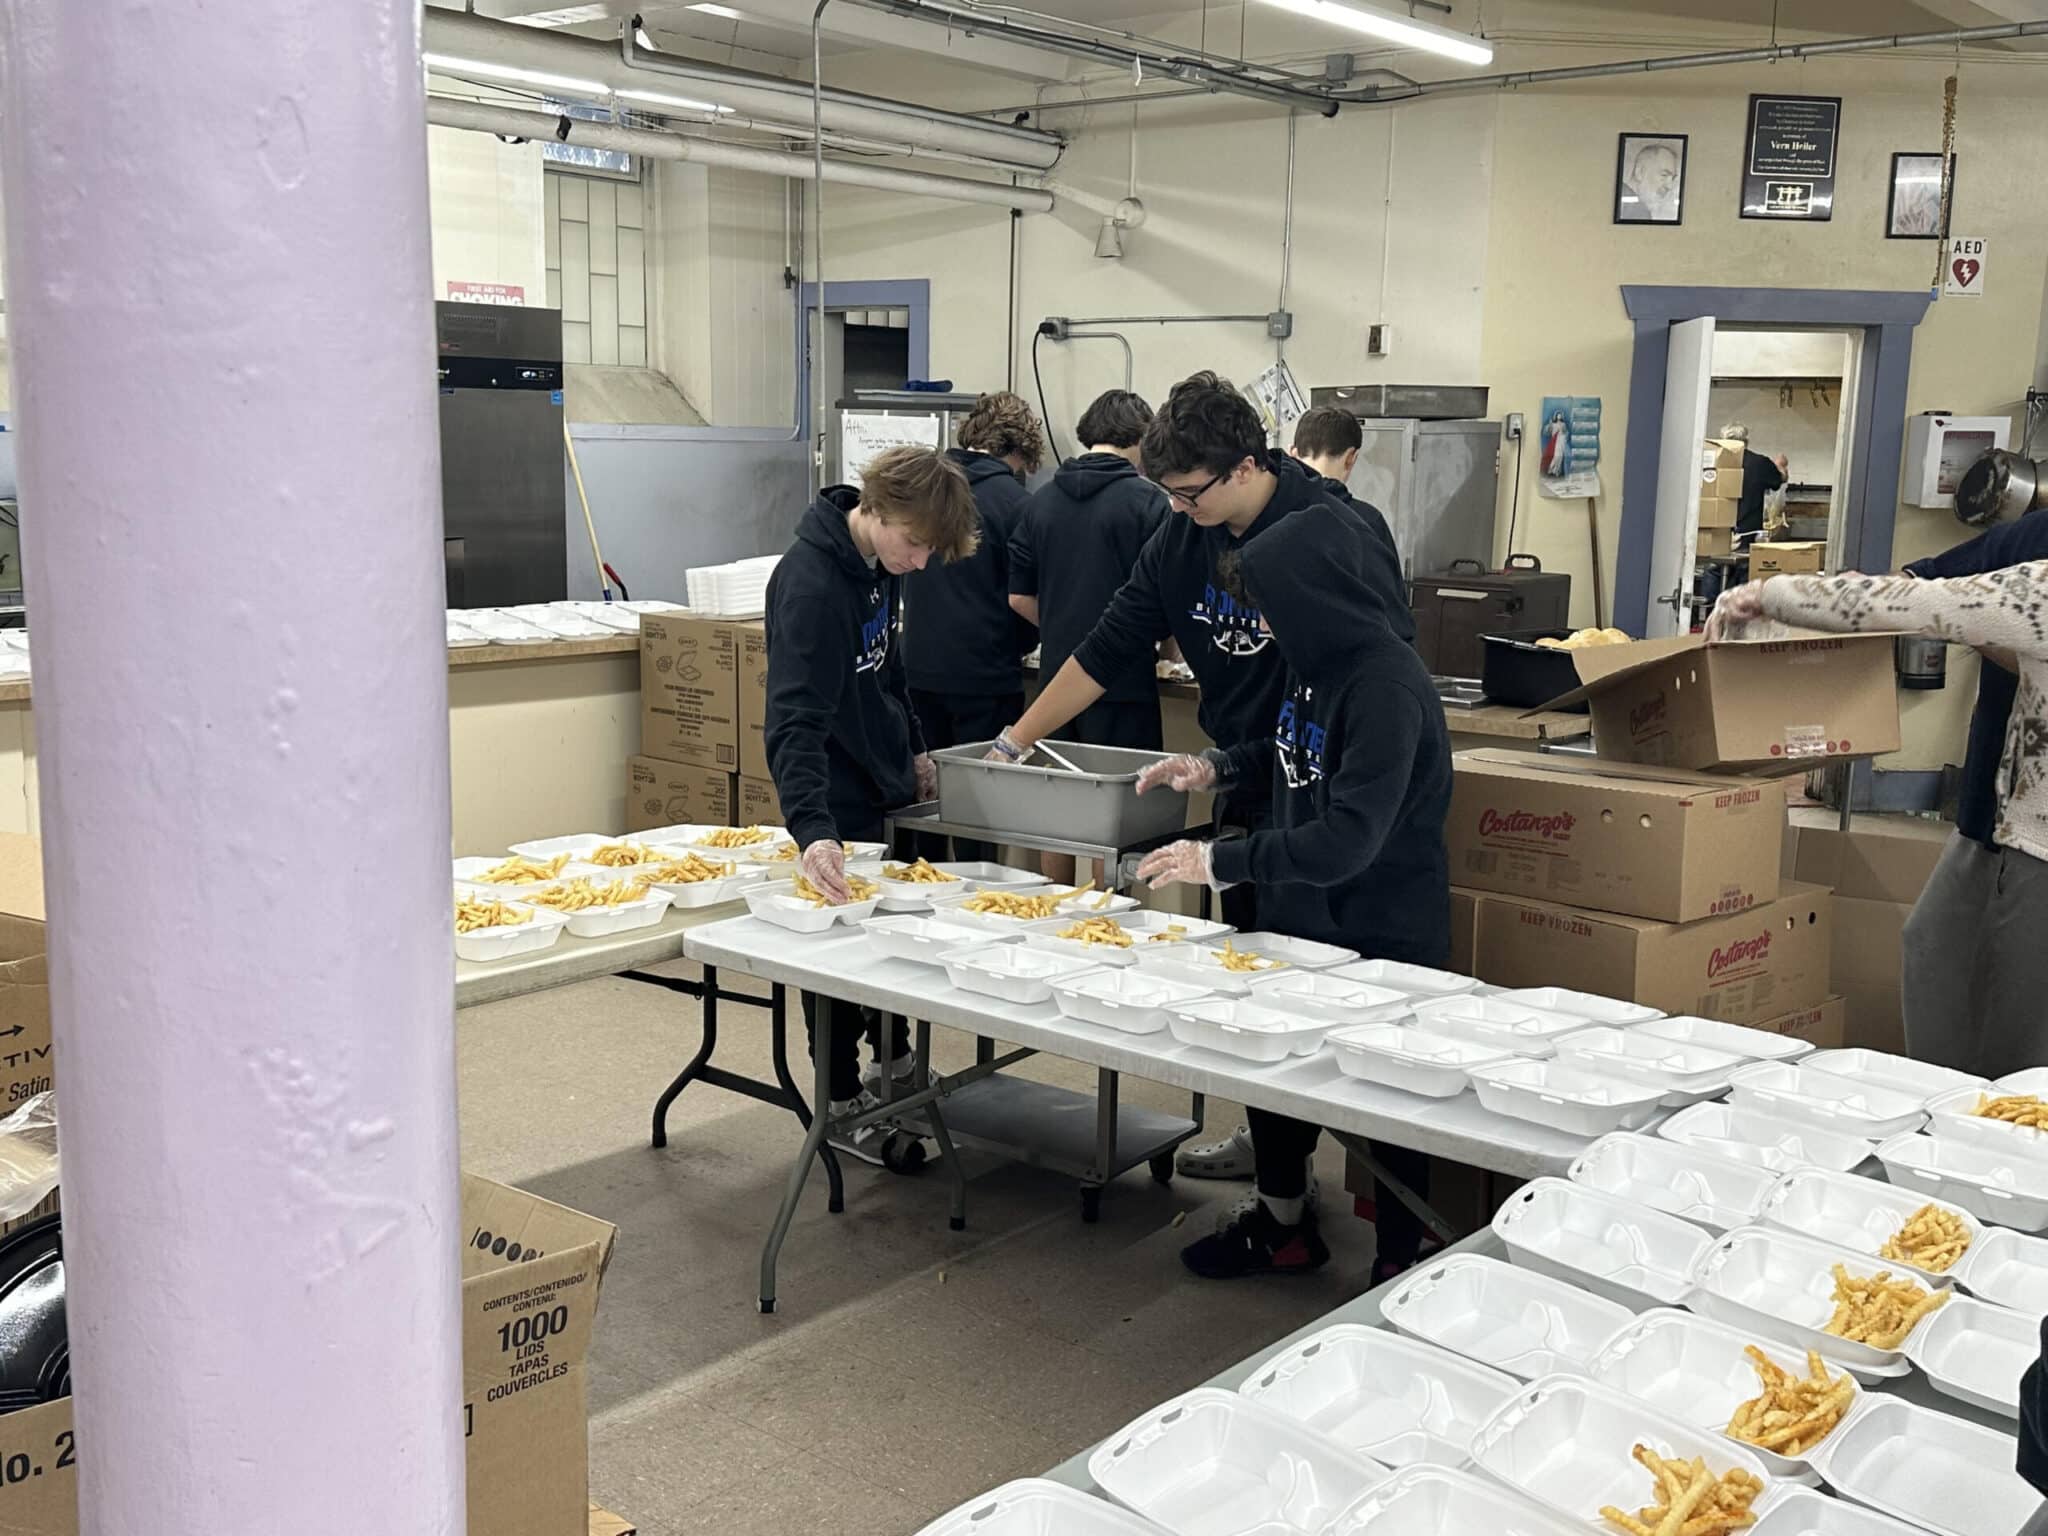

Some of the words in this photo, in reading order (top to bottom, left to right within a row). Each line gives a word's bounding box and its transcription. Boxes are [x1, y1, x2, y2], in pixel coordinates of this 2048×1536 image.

[1953, 240, 1983, 254] AED
[1715, 795, 1732, 808] KEEP
[1734, 790, 1760, 805] FROZEN
[1479, 808, 1576, 837] Costanzo's
[1520, 911, 1546, 926] KEEP
[1708, 929, 1771, 978] Costanzo's
[8, 1076, 50, 1102] Satin
[513, 1293, 557, 1313] CONTENU:
[497, 1305, 568, 1352] 1000
[516, 1340, 544, 1361] LIDS
[509, 1354, 549, 1378] TAPAS
[487, 1362, 568, 1402] COUVERCLES
